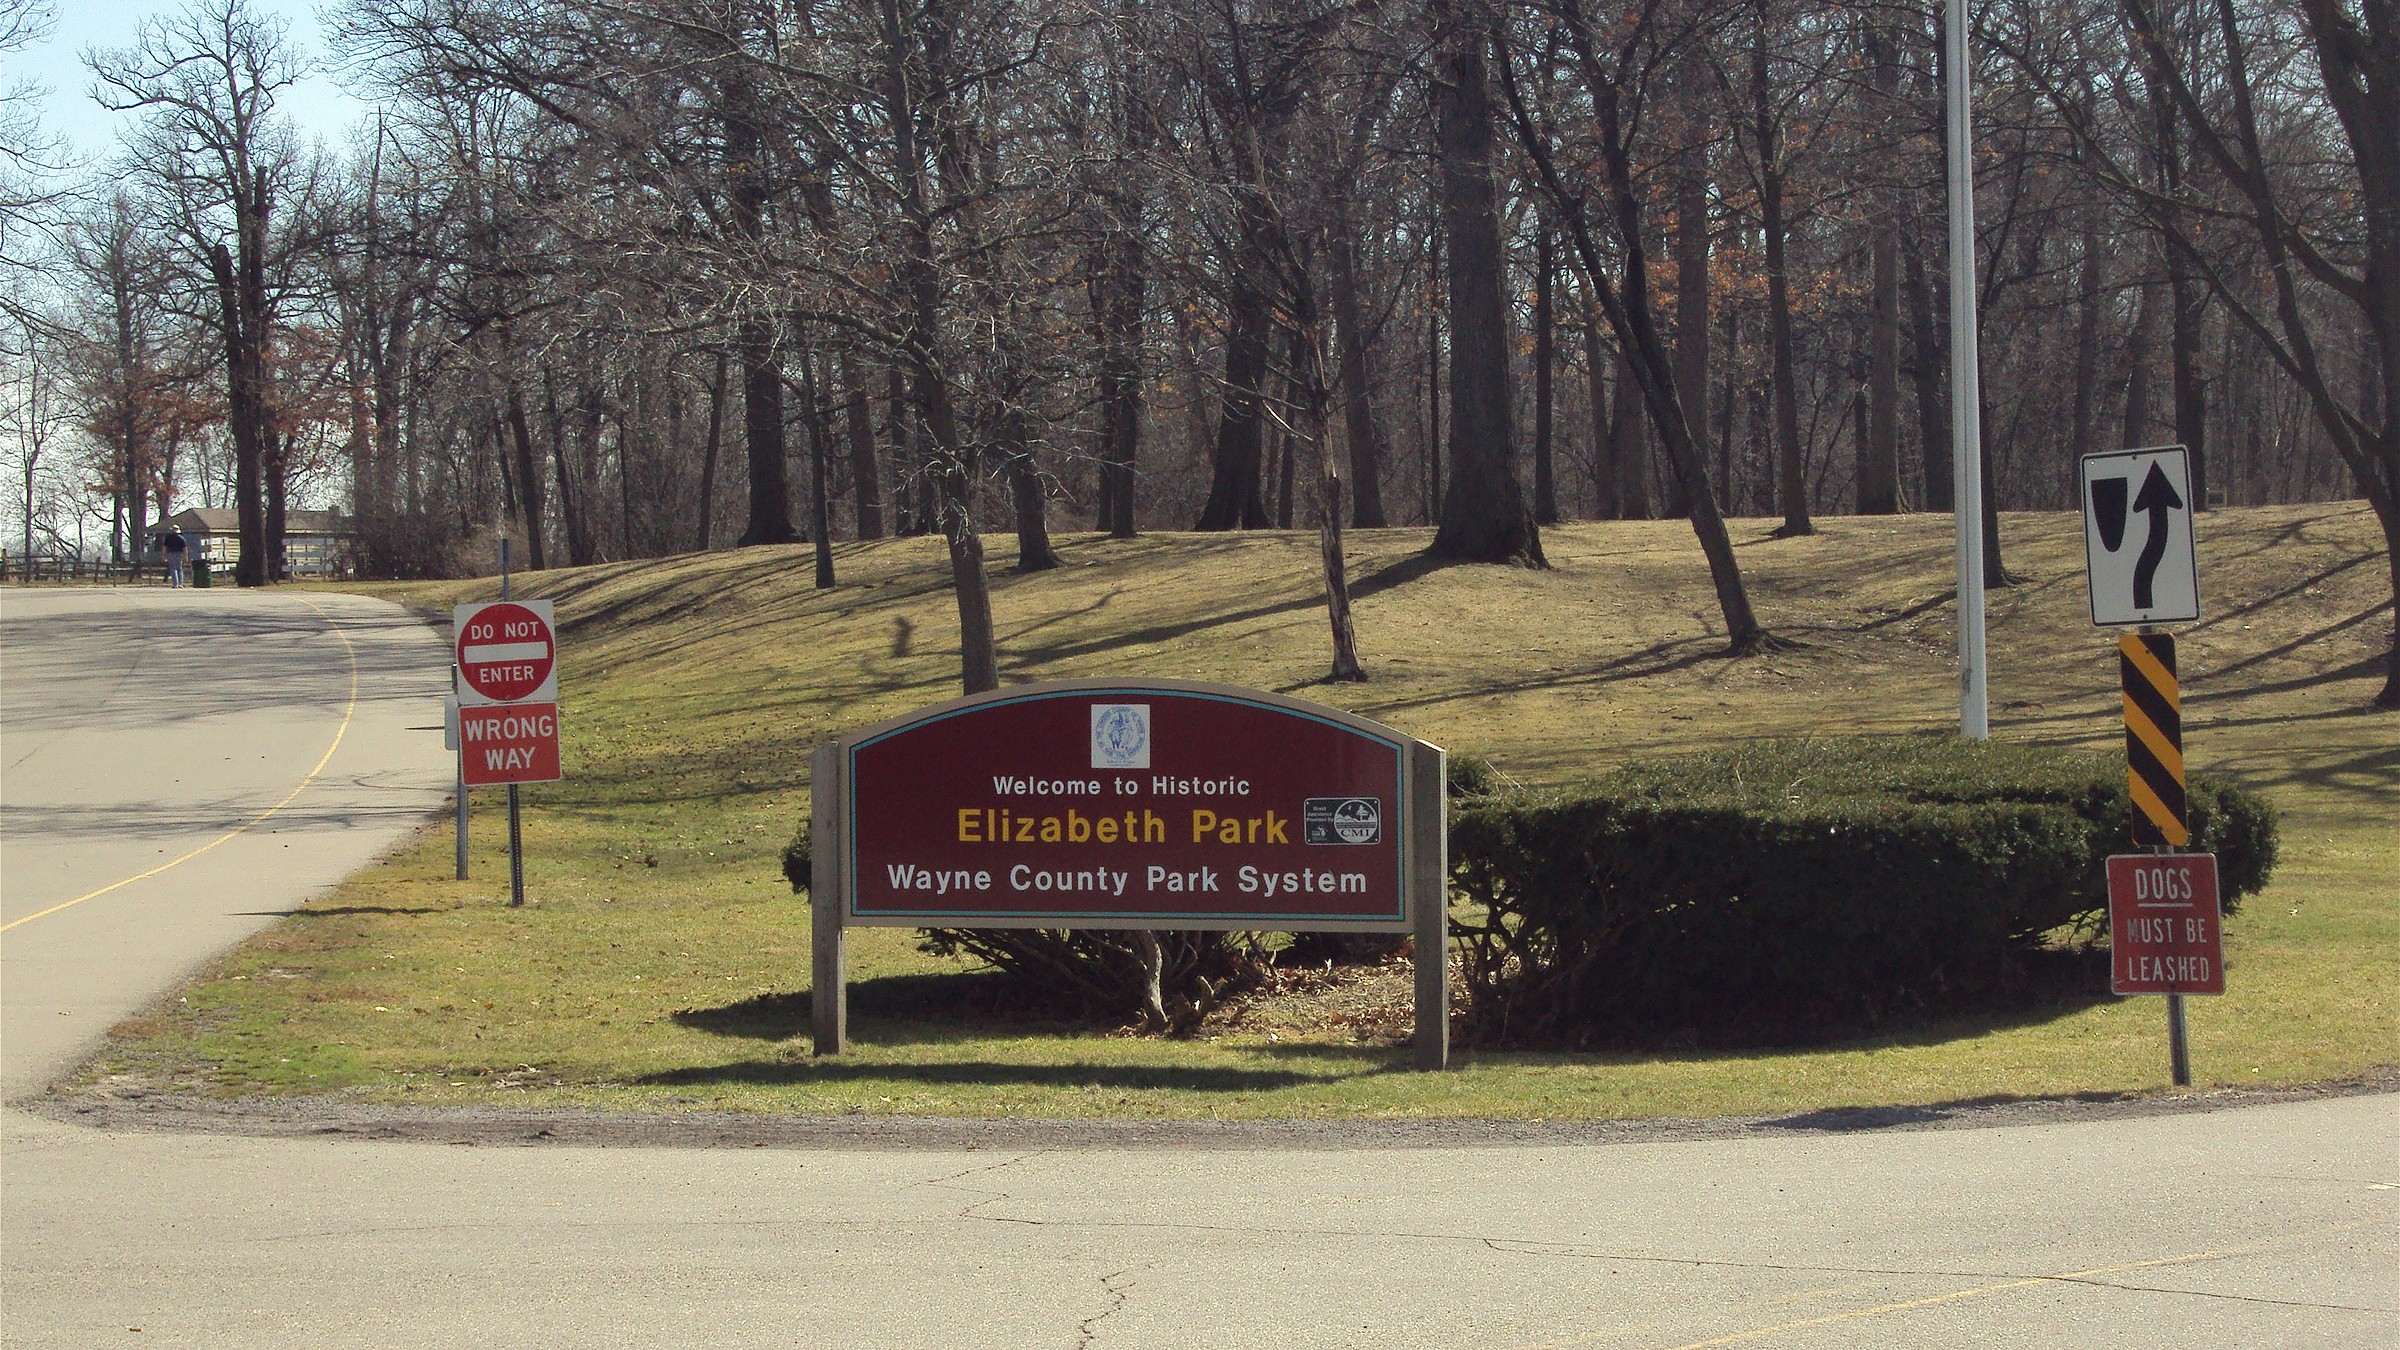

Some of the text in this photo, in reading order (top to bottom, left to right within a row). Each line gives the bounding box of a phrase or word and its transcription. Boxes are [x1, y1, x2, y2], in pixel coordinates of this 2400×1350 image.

[471, 622, 538, 639] DO NOT
[480, 666, 533, 683] ENTER
[465, 716, 553, 741] WRONG
[486, 747, 535, 770] WAY
[994, 776, 1249, 795] Welcome to Historic
[959, 809, 1288, 843] Elizabeth Park
[1341, 829, 1370, 837] CMI
[888, 865, 1366, 897] Wayne County Park System
[2135, 868, 2191, 899] DOGS
[2128, 918, 2206, 943] MUST BE
[2129, 956, 2209, 982] LEASHED
